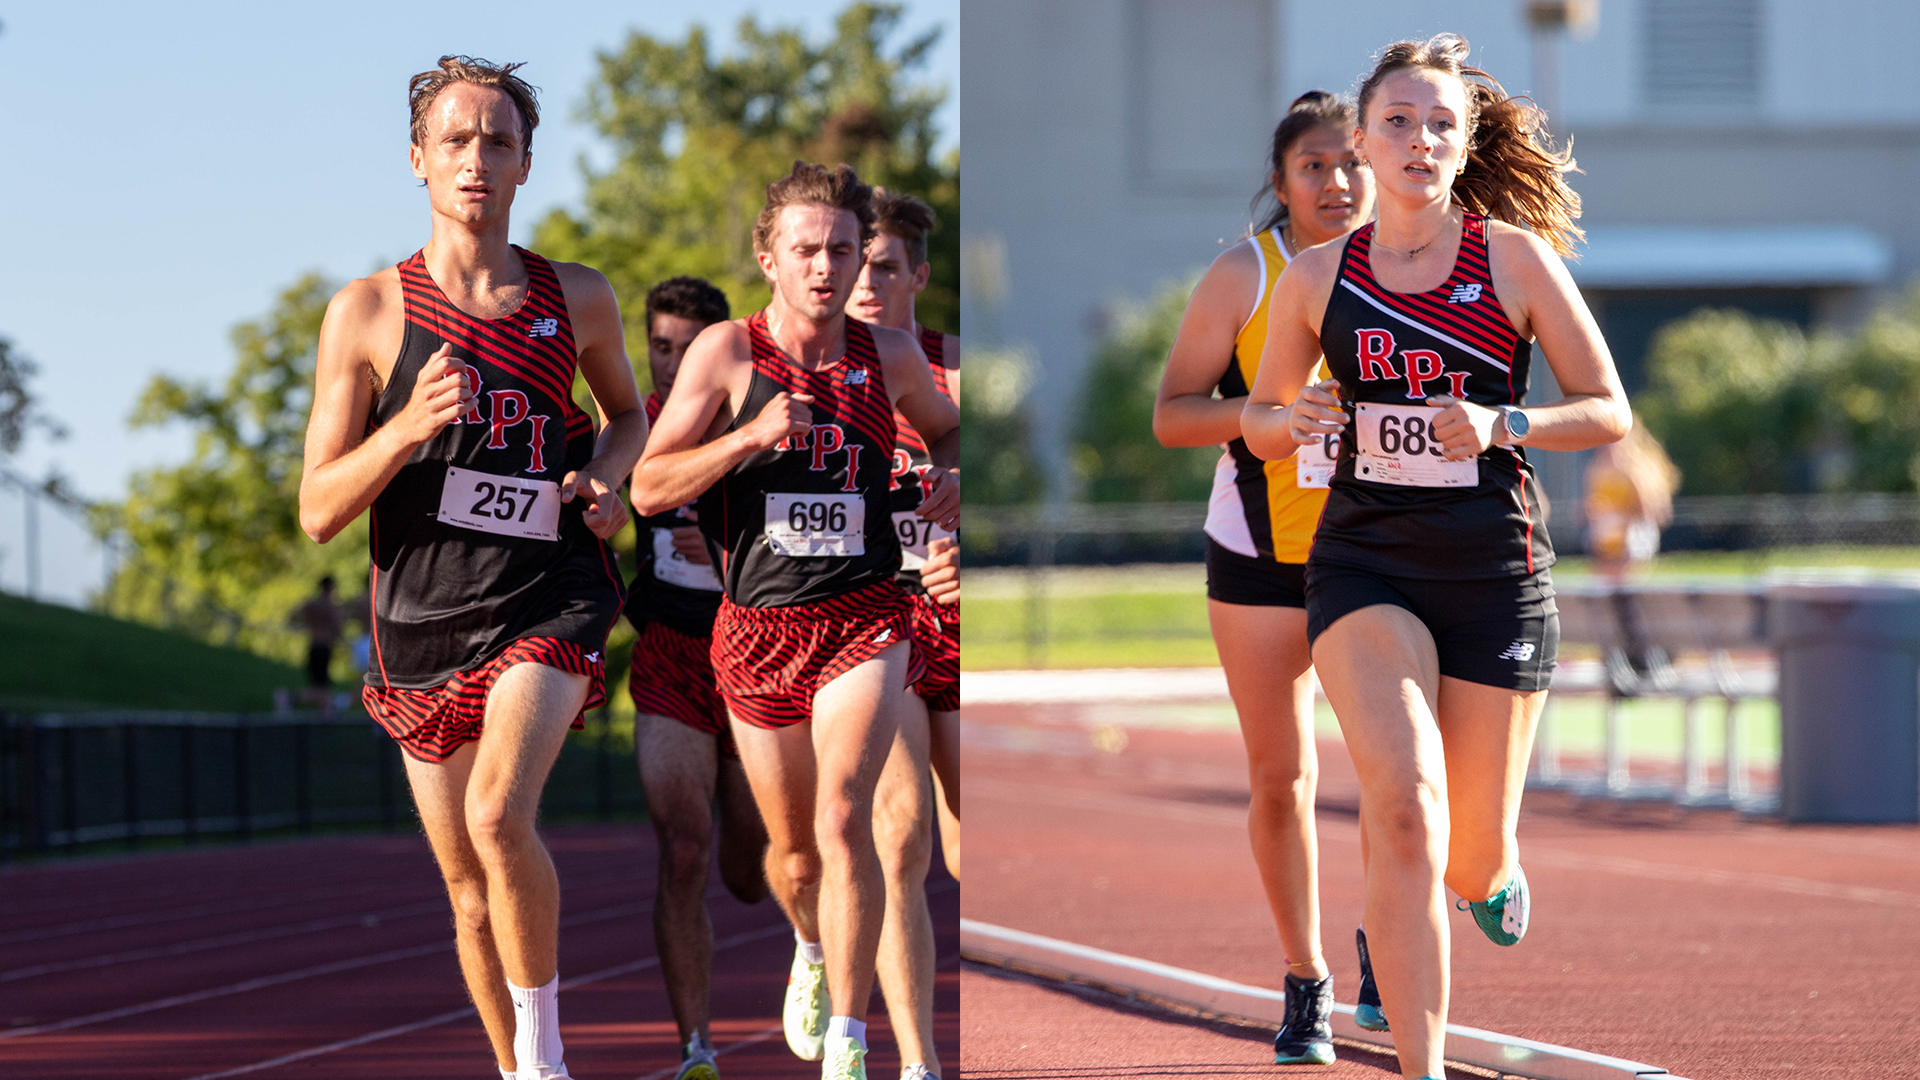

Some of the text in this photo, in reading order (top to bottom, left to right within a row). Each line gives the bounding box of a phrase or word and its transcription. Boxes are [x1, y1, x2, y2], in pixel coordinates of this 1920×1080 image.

[889, 448, 934, 505] PI
[470, 481, 539, 523] 257
[788, 502, 847, 532] 696
[899, 519, 933, 547] 97
